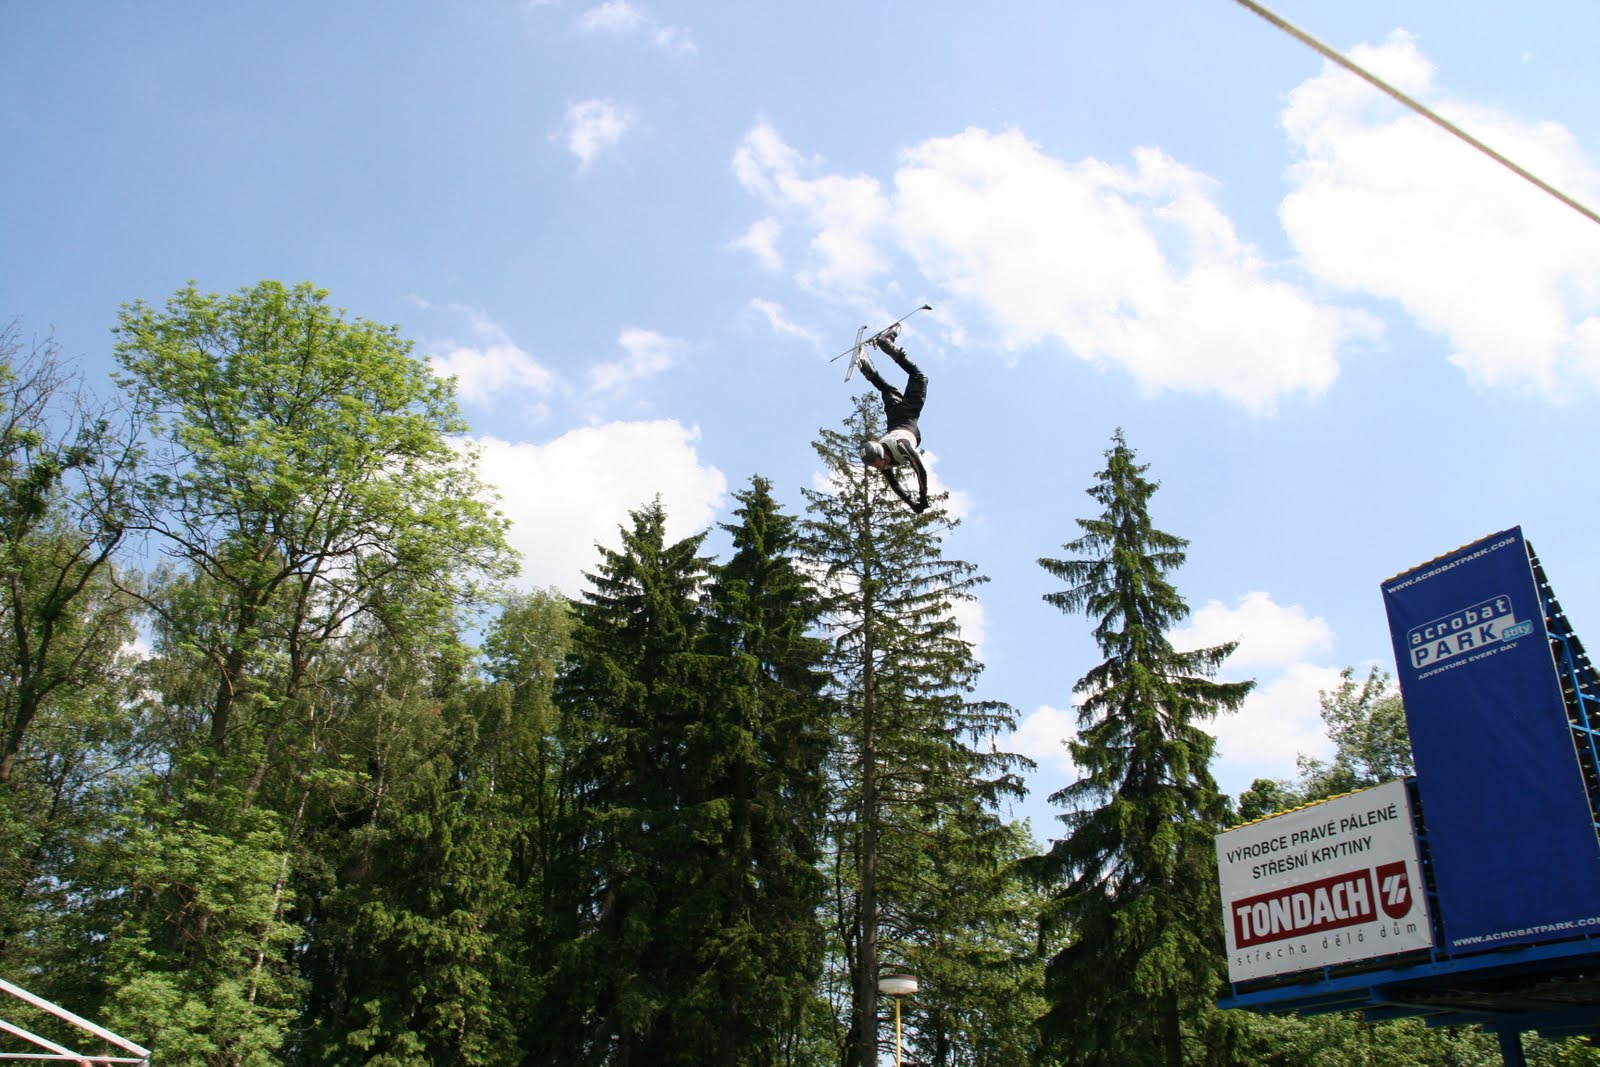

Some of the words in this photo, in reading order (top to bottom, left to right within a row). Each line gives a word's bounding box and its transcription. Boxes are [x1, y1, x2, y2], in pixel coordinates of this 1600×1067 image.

[1388, 537, 1515, 593] WWW.ACROBATPARK.COM
[1411, 599, 1506, 645] acrobat
[1414, 623, 1498, 667] PARK
[1418, 659, 1467, 681] ADVENTURE
[1469, 649, 1498, 663] EVERY
[1500, 642, 1518, 653] DAY
[1227, 836, 1288, 864] VÝROBCE
[1292, 820, 1337, 847] PRAVÉ
[1341, 805, 1398, 832] PÁLENÉ
[1252, 855, 1309, 880] STŘEŠNÍ
[1312, 836, 1373, 860] KRYTINY
[1236, 878, 1371, 941] TONDACH
[1380, 921, 1417, 938] dům
